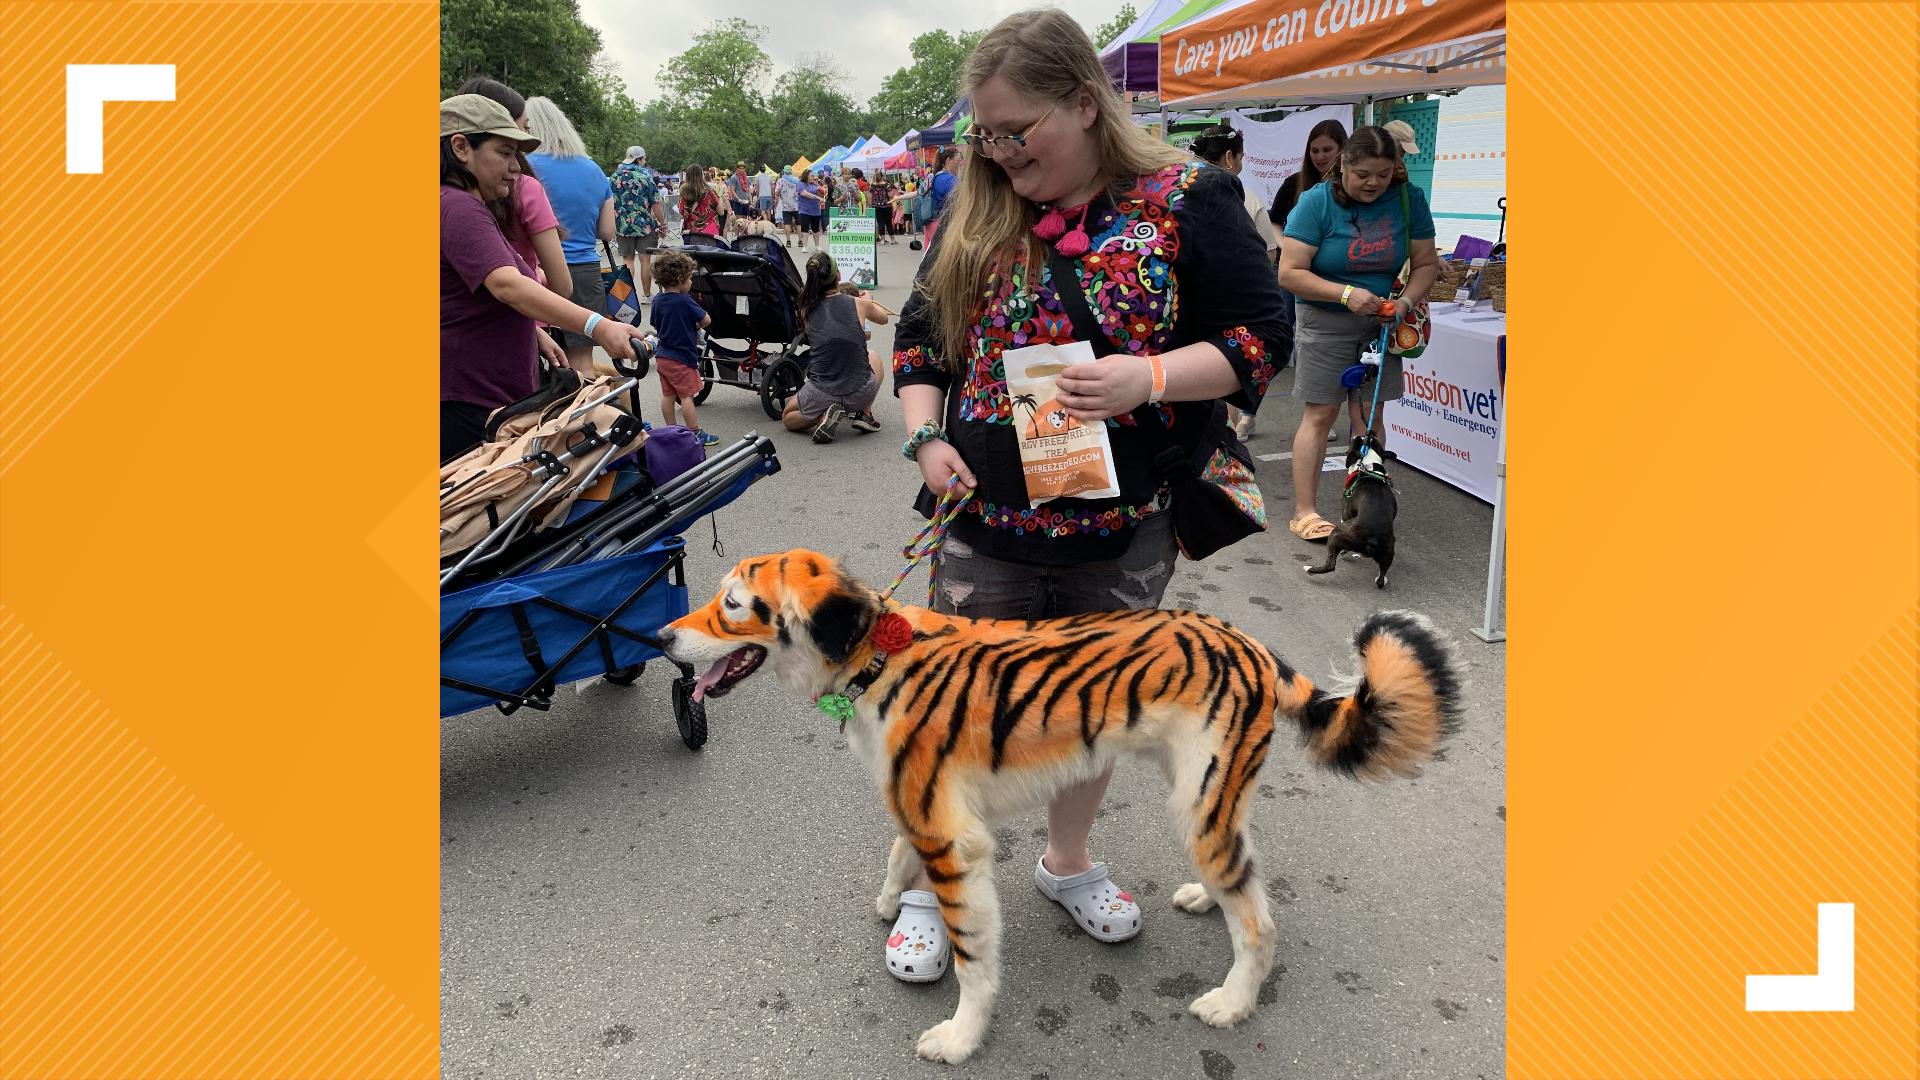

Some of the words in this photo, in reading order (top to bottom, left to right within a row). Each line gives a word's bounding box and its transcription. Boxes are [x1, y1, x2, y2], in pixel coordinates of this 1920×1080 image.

[1174, 38, 1215, 76] Care
[1215, 25, 1258, 77] you
[1262, 8, 1307, 52] can
[832, 246, 872, 255] $35,000
[1443, 409, 1498, 438] Emergency
[1022, 441, 1038, 450] RGV
[1040, 436, 1068, 448] FREEZ
[1068, 427, 1092, 440] RIED
[1391, 423, 1472, 462] www.mission.vet
[1044, 447, 1069, 458] TREA
